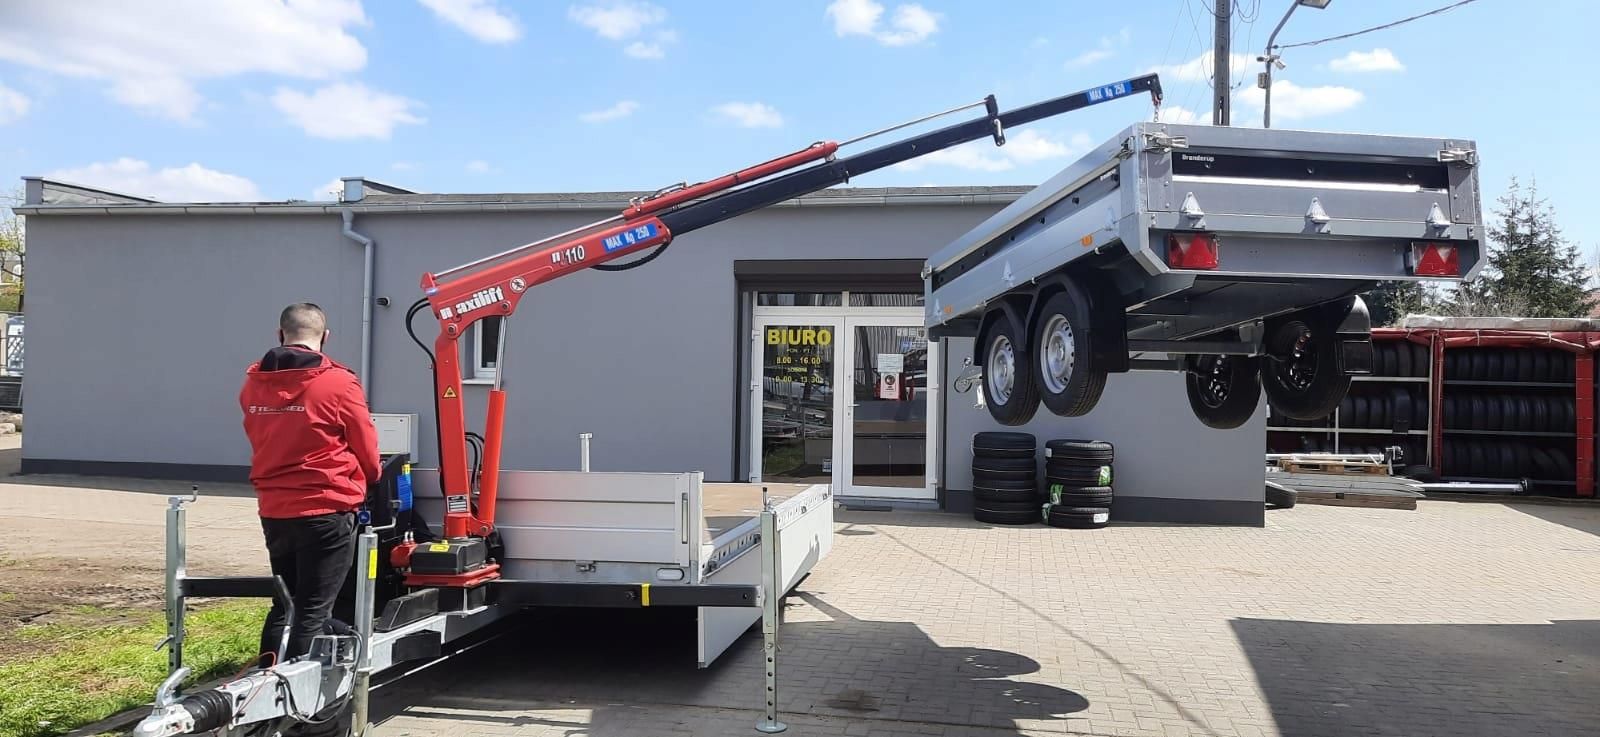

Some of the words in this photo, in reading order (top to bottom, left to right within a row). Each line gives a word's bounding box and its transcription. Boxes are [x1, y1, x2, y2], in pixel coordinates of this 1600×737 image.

[1088, 87, 1103, 101] MAX
[605, 235, 623, 250] MAX
[624, 231, 636, 245] Kg
[635, 225, 651, 240] 250
[767, 328, 832, 346] BIURO
